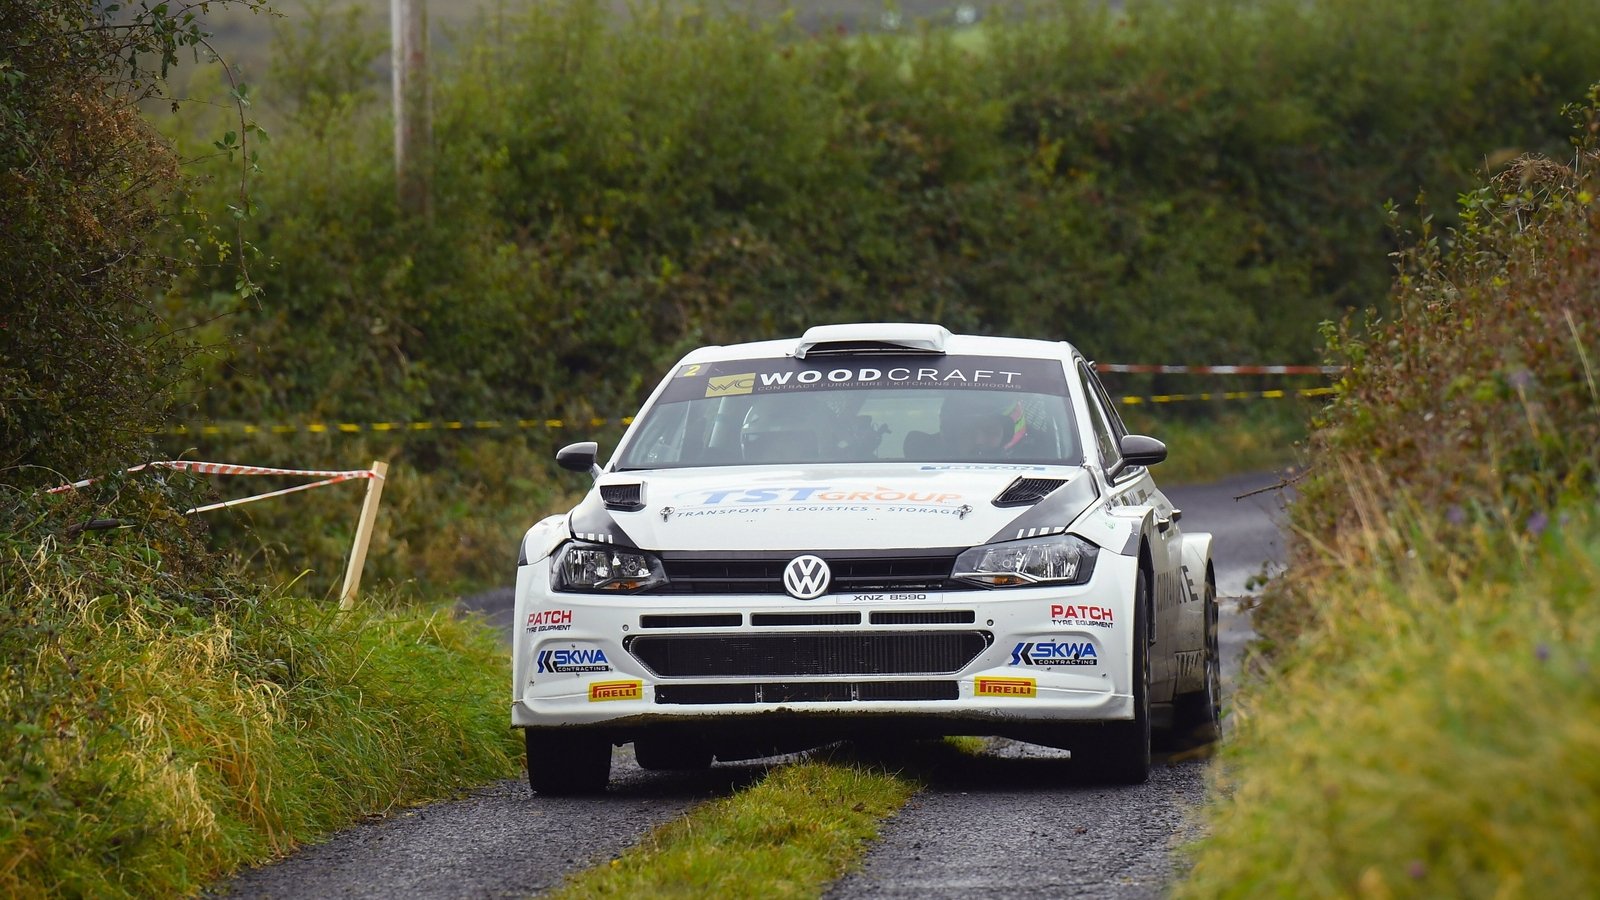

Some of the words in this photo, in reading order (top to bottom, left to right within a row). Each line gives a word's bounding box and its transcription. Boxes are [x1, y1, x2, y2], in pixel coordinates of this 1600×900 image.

[684, 365, 700, 377] 2
[760, 368, 1022, 385] WOODCRAFT
[677, 507, 770, 518] TRANSPORT
[887, 506, 961, 515] STORAGE
[784, 555, 831, 600] VW
[527, 610, 572, 626] PATCH
[1051, 605, 1113, 621] PATCH
[1076, 620, 1113, 628] EQUIPMENT
[555, 650, 608, 664] SKWA
[1031, 643, 1097, 657] SKWA
[592, 684, 637, 698] PIRELLI
[979, 680, 1031, 694] PIRELLI
